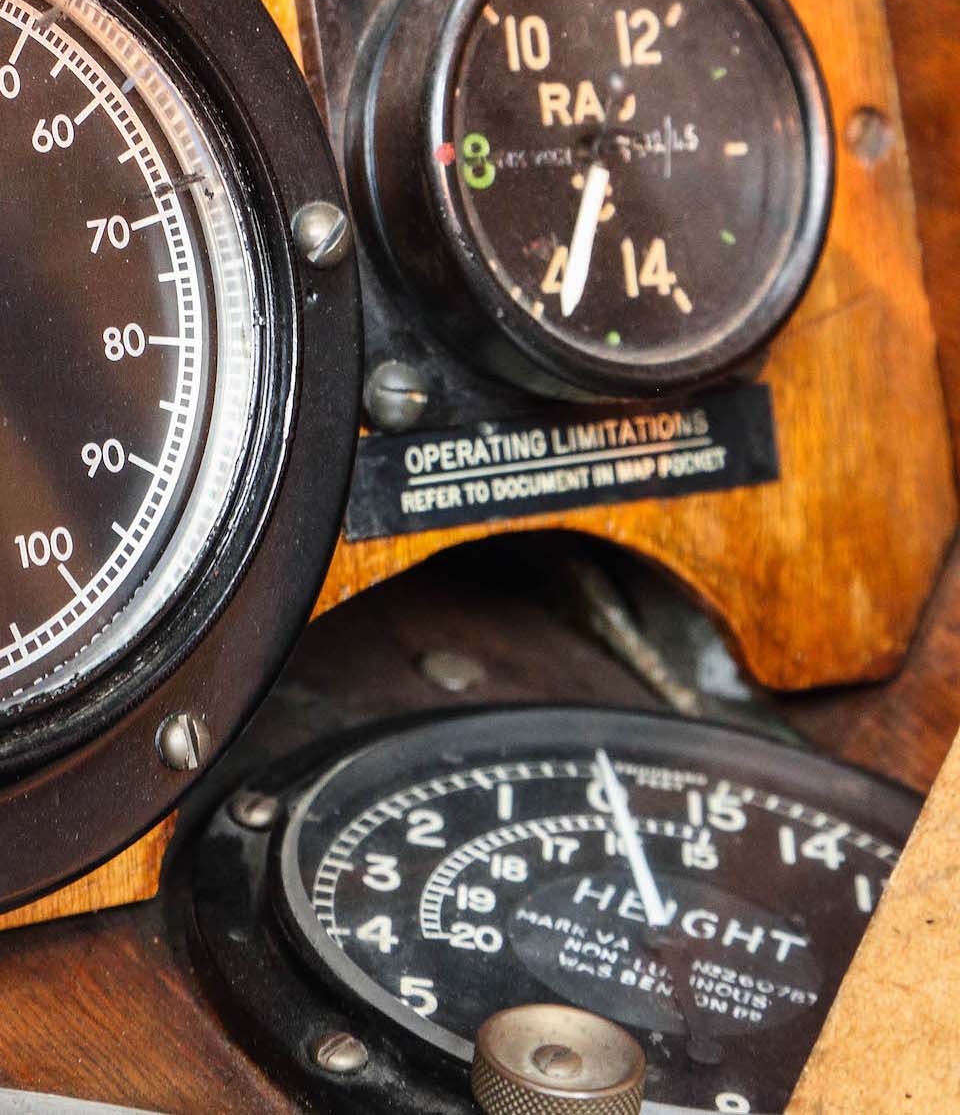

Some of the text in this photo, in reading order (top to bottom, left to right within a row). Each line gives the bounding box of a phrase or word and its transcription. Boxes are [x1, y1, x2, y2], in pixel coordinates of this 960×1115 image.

[504, 14, 551, 72] 10
[614, 8, 663, 68] 12
[31, 113, 76, 152] 60
[462, 132, 496, 190] 8
[87, 214, 132, 251] 70
[621, 237, 677, 299] 14
[102, 324, 146, 361] 80
[80, 438, 126, 479] 90
[404, 409, 710, 475] OPERATING LIMITATIONS
[401, 486, 462, 514] REFER
[464, 481, 491, 504] TO
[492, 465, 590, 501] DOCUMENT
[591, 463, 616, 487] IN
[656, 446, 727, 479] POCKET
[14, 526, 73, 569] 100
[497, 783, 514, 821] 1
[686, 781, 747, 832] 15
[405, 808, 446, 848] 2
[778, 822, 850, 870] 14
[490, 853, 528, 883] 18
[542, 836, 581, 864] 17
[681, 830, 719, 870] 15
[362, 853, 401, 892] 3
[456, 882, 496, 914] 19
[356, 914, 399, 954] 4
[449, 920, 503, 954] 20
[400, 975, 439, 1019] 5
